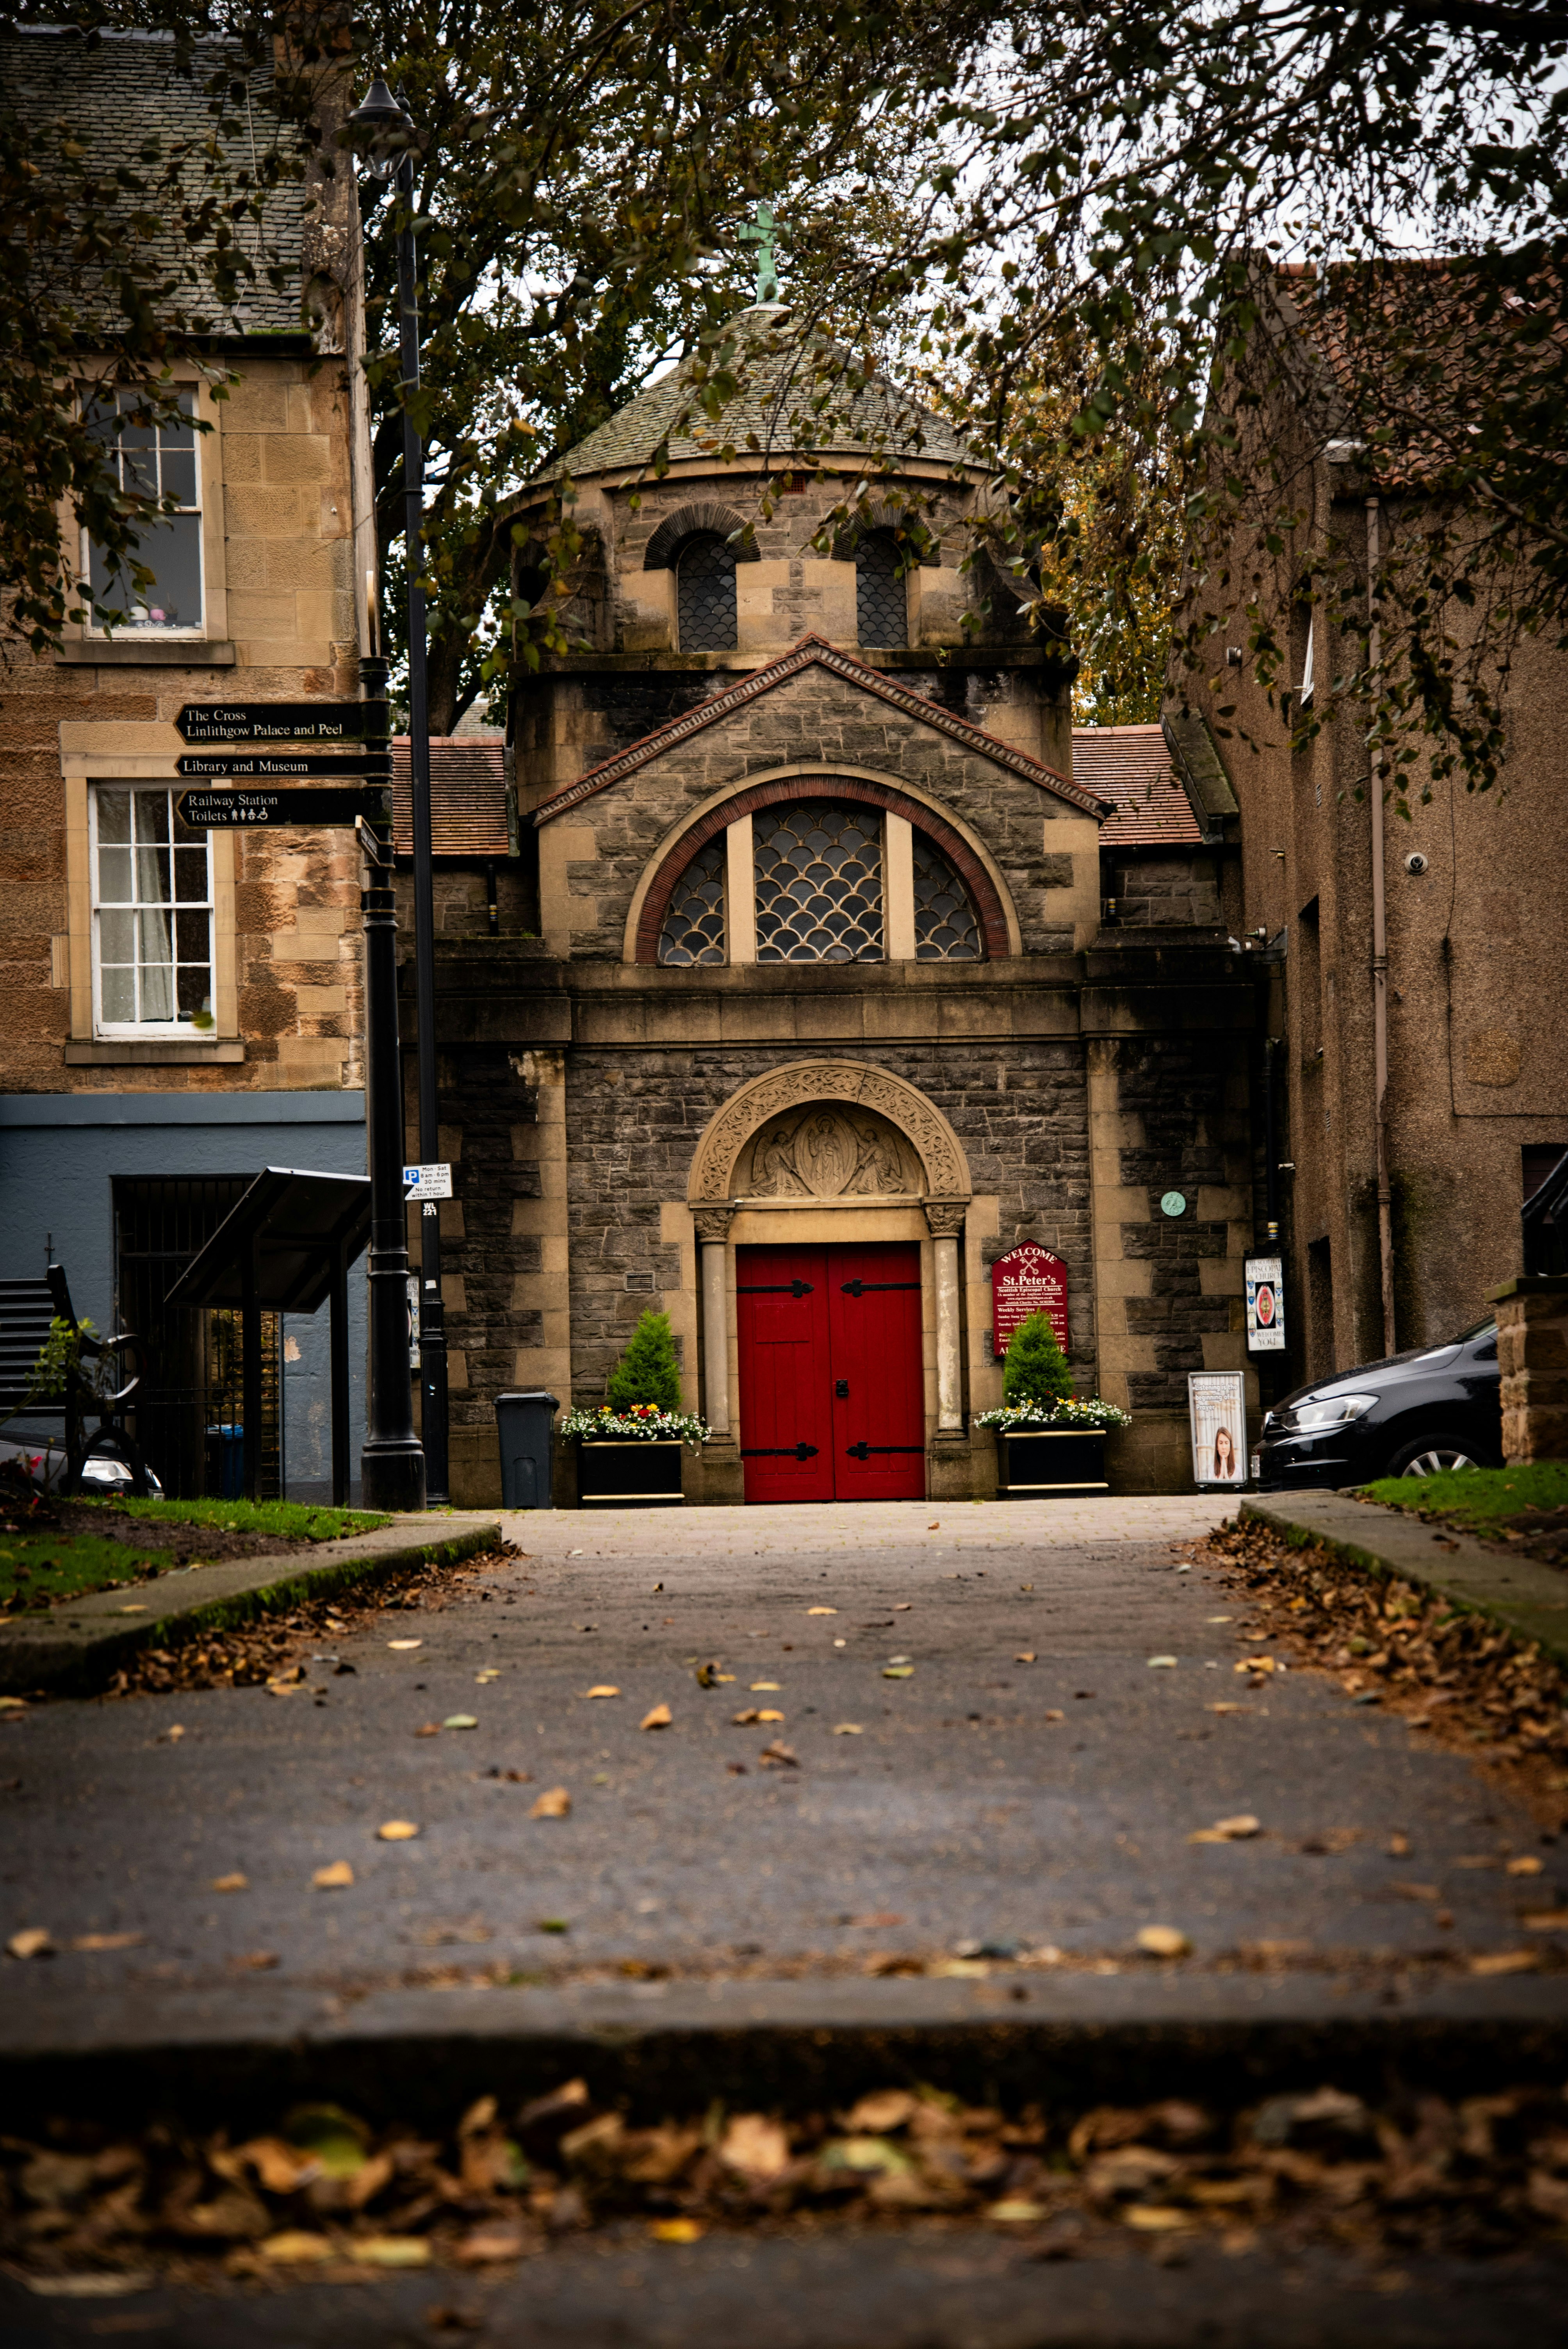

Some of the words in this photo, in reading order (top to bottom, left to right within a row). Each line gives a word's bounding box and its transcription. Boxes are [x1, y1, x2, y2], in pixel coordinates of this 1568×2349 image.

[185, 710, 209, 721] The
[214, 709, 246, 720] Cross
[186, 725, 250, 738] Linlithgow
[253, 724, 290, 735] Palace
[294, 724, 314, 735] and
[318, 724, 342, 735] Peel
[184, 760, 228, 774] Library
[233, 760, 253, 772] and
[259, 761, 308, 772] Museum
[189, 795, 235, 808] Railway
[238, 794, 278, 805] Station
[189, 810, 227, 821] Toilets
[1000, 1247, 1058, 1264] WELCOME
[1247, 1264, 1282, 1273] EPISCOPAL
[1003, 1275, 1056, 1286] St.Peter's
[1256, 1272, 1282, 1280] CHURCH
[1258, 1337, 1276, 1346] YOU
[1194, 1383, 1221, 1392] Listening
[1195, 1393, 1222, 1402] beginning
[1196, 1403, 1215, 1412] Prayer
